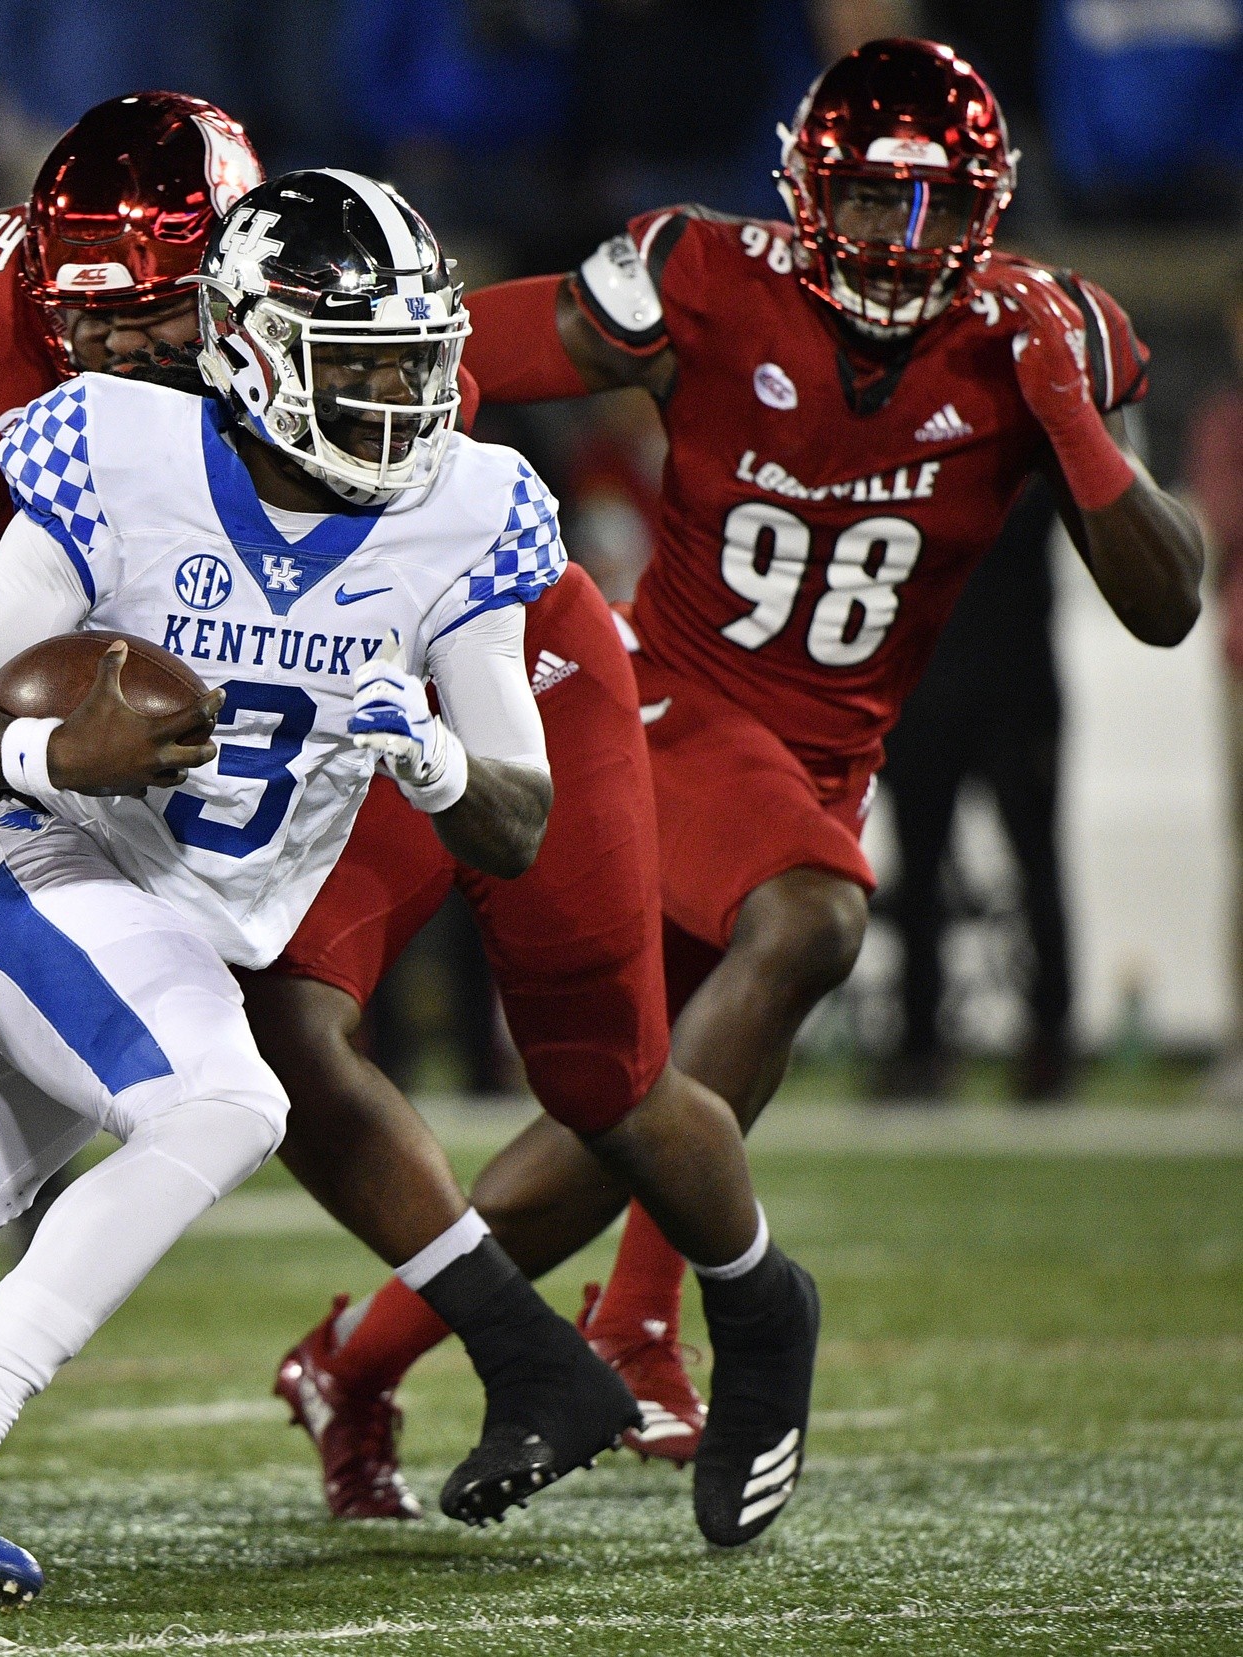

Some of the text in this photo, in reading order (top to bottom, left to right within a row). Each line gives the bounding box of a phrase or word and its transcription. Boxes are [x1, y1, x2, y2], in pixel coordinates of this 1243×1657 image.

[74, 268, 109, 280] ACC
[219, 208, 284, 296] UK
[405, 297, 431, 320] UK
[177, 557, 230, 608] SEC
[262, 555, 303, 592] UK
[720, 502, 922, 666] 98
[163, 679, 318, 859] 3
